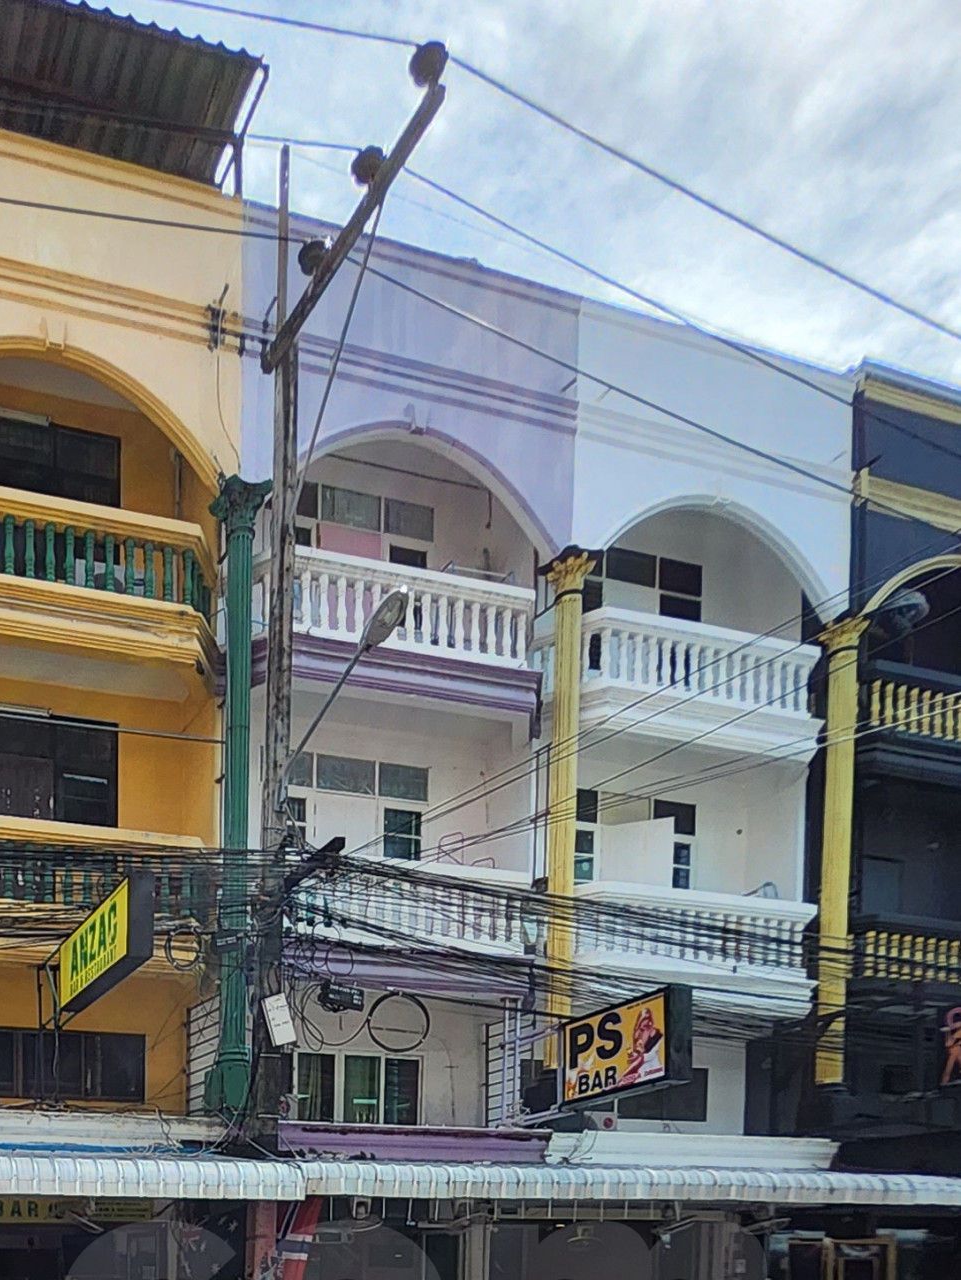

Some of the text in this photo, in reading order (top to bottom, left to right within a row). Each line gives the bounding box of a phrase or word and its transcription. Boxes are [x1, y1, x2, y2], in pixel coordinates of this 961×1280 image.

[70, 899, 118, 978] ANZAC
[569, 1011, 623, 1070] PS
[578, 1065, 617, 1095] BAR
